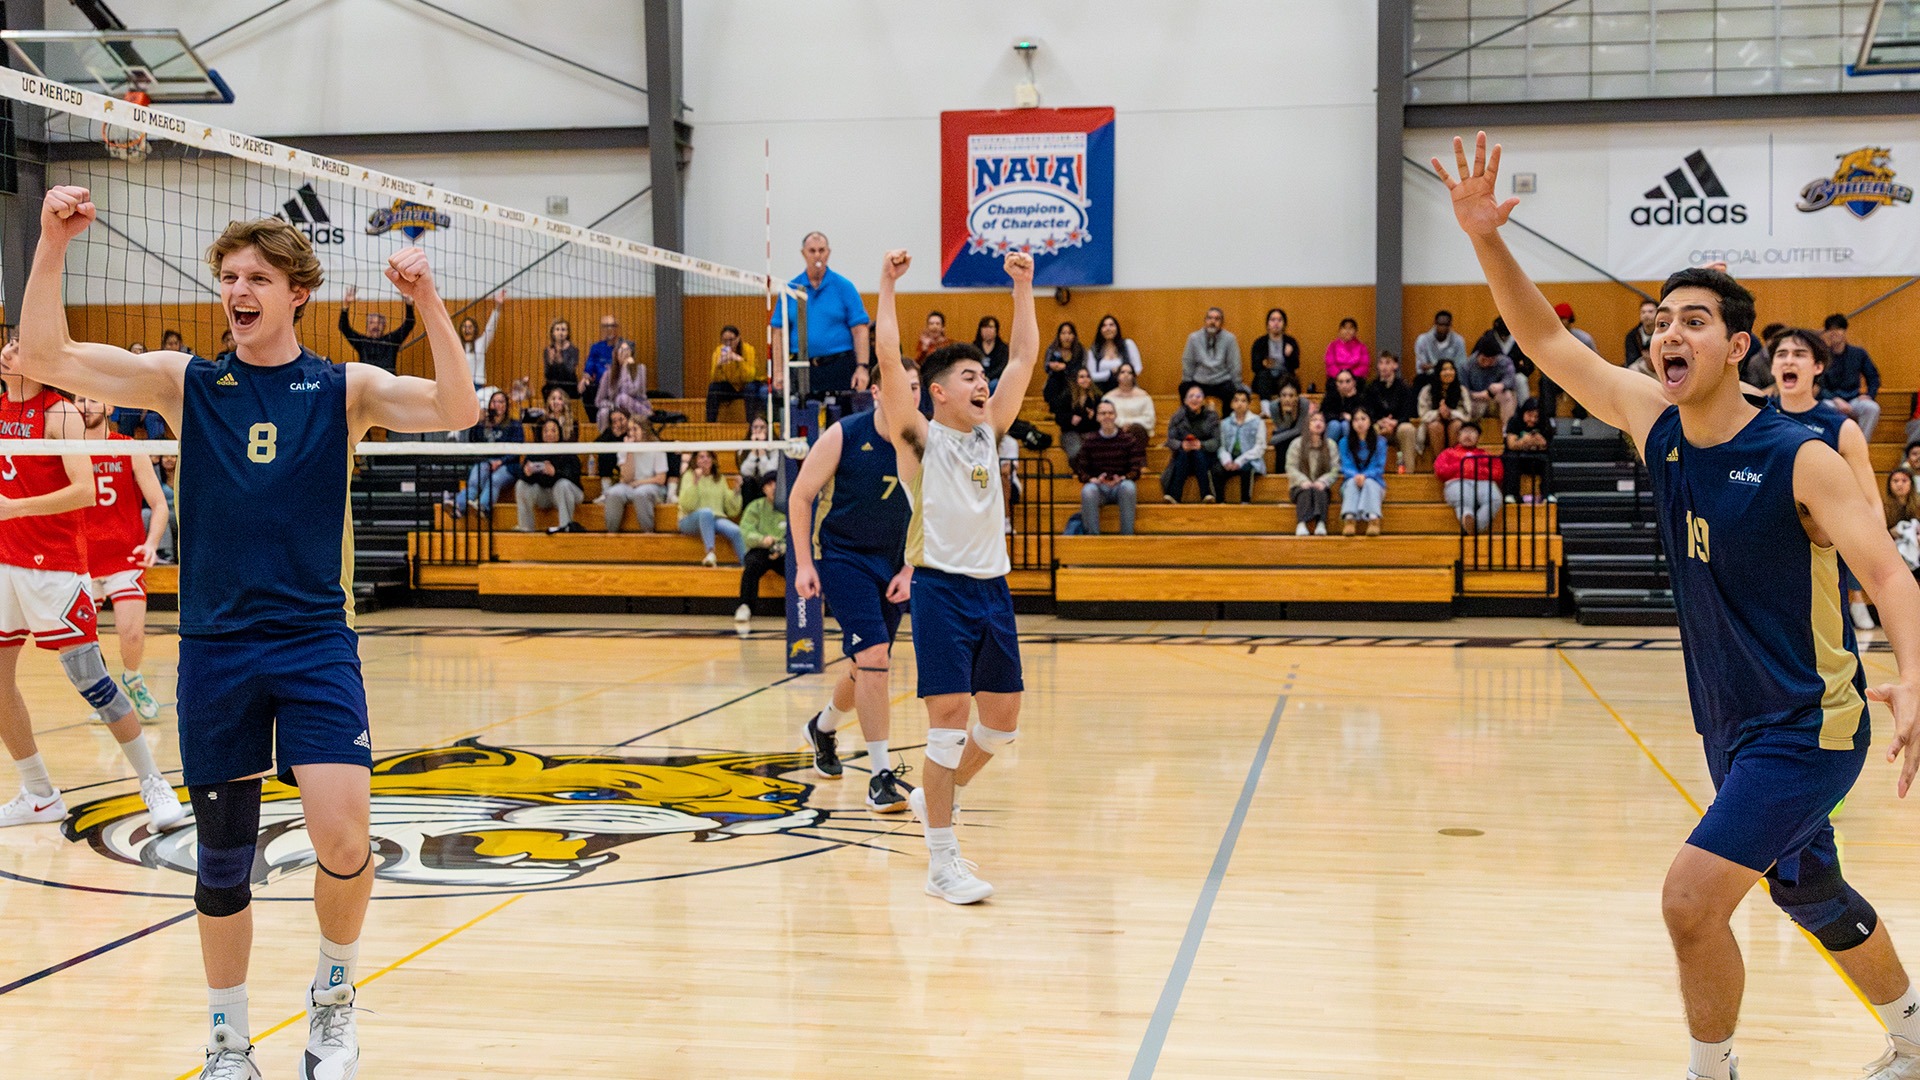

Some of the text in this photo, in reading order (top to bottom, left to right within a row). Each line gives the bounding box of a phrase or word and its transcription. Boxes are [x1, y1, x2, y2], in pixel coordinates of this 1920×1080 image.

[21, 77, 83, 106] UC MERCED
[133, 108, 186, 134] UC MERCED
[229, 134, 274, 156] UC MERCED
[311, 156, 350, 177] UC MERCED
[975, 156, 1079, 196] NAIA
[988, 204, 1065, 216] Champions
[1630, 200, 1748, 226] adidas
[982, 219, 1071, 229] of Character
[1688, 247, 1855, 265] OFFICIAL OUTFITTER
[306, 381, 321, 390] PAC
[247, 422, 278, 464] 8
[881, 475, 898, 500] 7
[971, 464, 989, 488] 4
[1729, 470, 1763, 483] CAL PAC
[1686, 510, 1710, 563] 19
